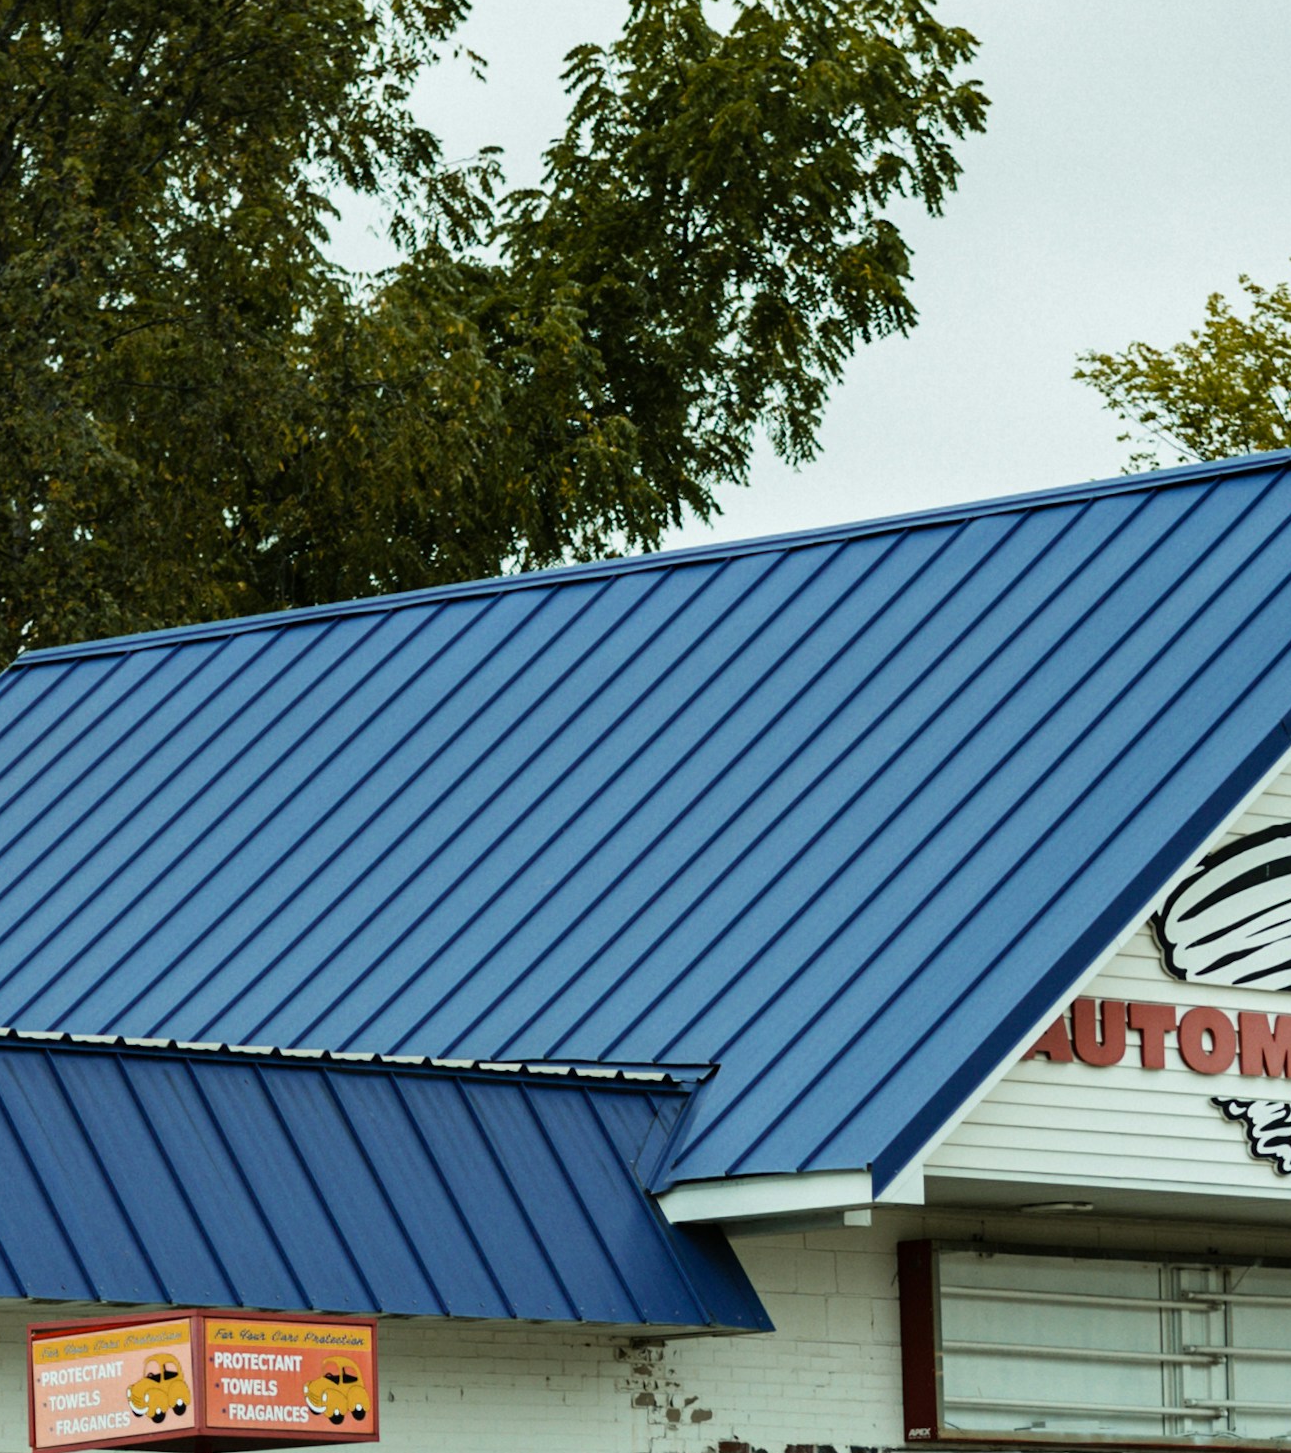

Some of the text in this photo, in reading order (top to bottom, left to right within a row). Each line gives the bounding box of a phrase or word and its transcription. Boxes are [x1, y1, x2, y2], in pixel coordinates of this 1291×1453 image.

[214, 1328, 364, 1346] For Your Cars Protection
[214, 1351, 303, 1372] PROTECTANT
[41, 1360, 124, 1387] PROTECTANT
[221, 1378, 278, 1397] TOWELS
[49, 1390, 101, 1412] TOWELS
[228, 1403, 309, 1423] FRAGANCES
[56, 1411, 131, 1437] FRAGANCES
